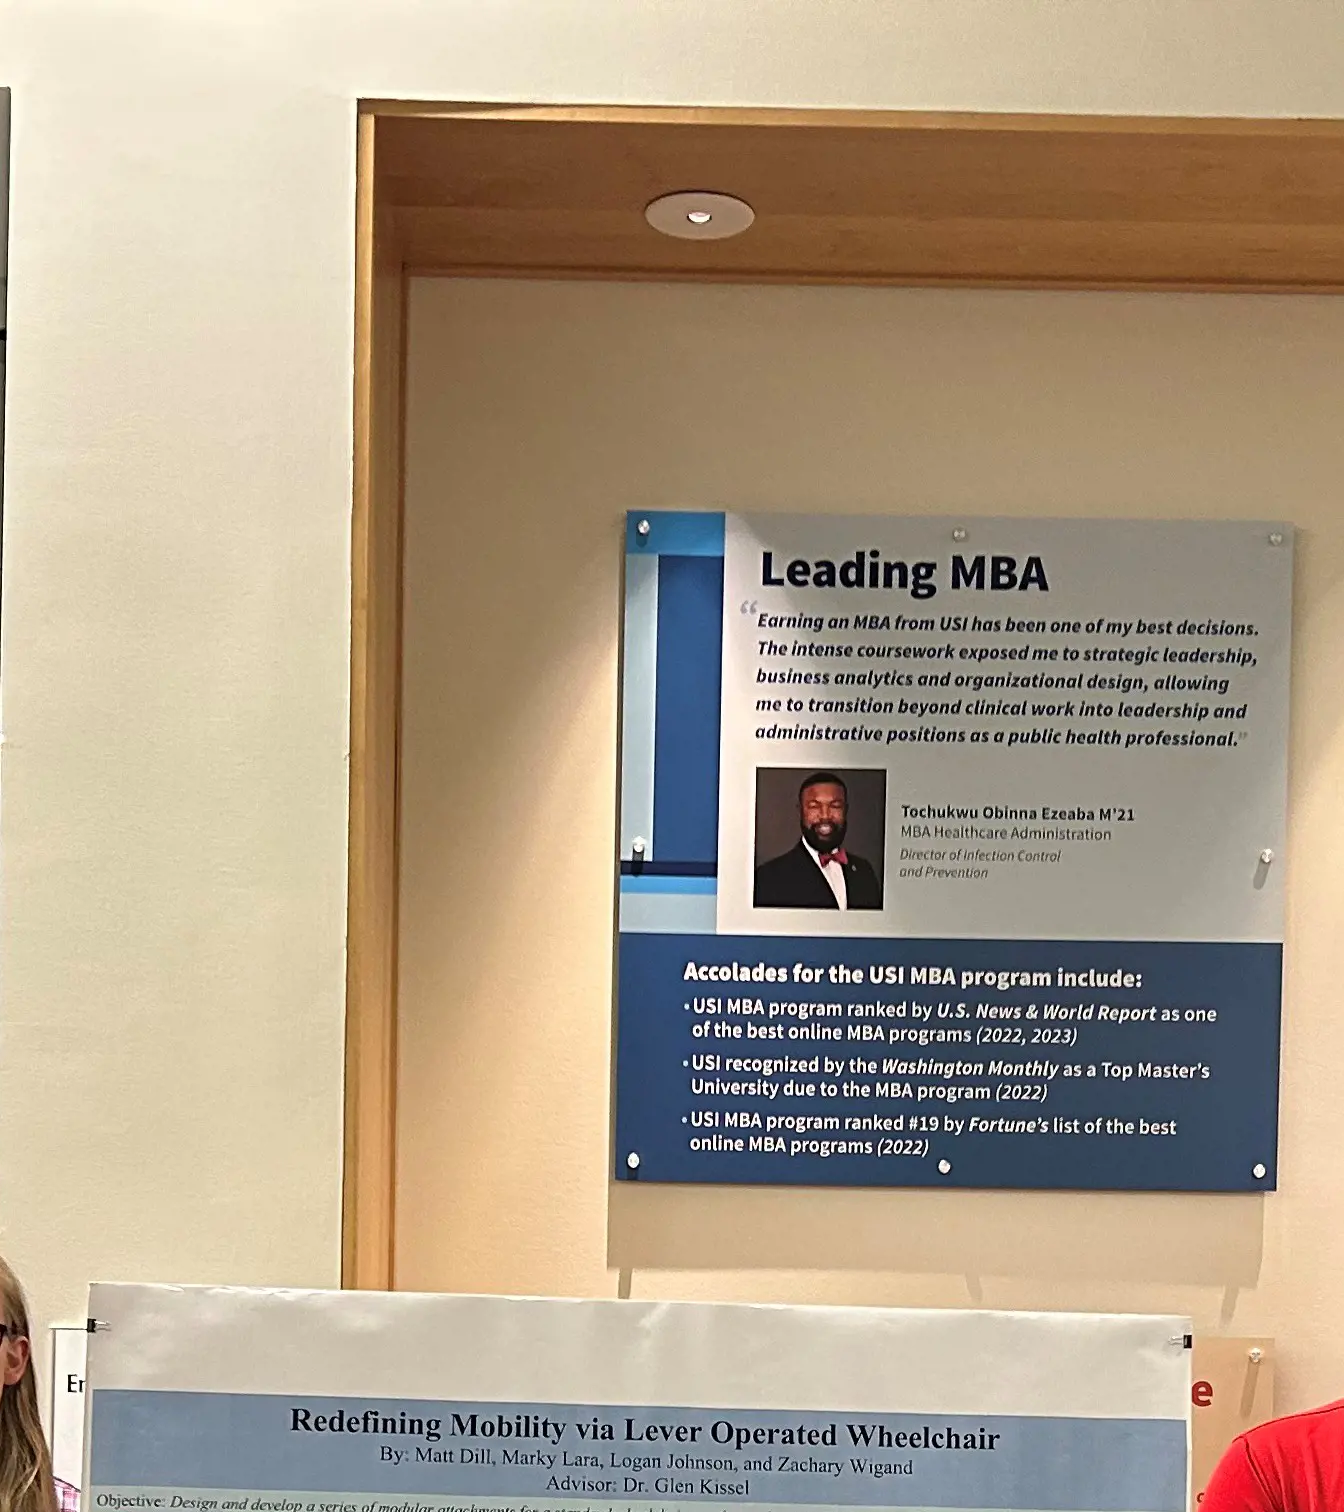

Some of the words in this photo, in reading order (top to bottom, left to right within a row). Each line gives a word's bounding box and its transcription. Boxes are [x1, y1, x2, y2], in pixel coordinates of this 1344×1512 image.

[761, 550, 937, 599] Leading
[950, 554, 1049, 592] MBA
[827, 616, 850, 630] an
[852, 614, 891, 630] MBA
[894, 614, 935, 632] from
[939, 615, 968, 632] USI
[970, 615, 1001, 632] has
[1004, 616, 1046, 633] been
[1050, 620, 1082, 634] one
[1084, 618, 1105, 634] of
[1105, 621, 1133, 638] my
[1135, 618, 1173, 635] best
[1176, 618, 1259, 636] decisions.
[900, 824, 931, 839] MBA
[934, 824, 1008, 840] Healthcare
[1010, 825, 1112, 841] Administration
[899, 847, 947, 861] Director
[948, 847, 963, 861] of
[962, 847, 1015, 862] Infection
[1016, 848, 1062, 863] Control
[682, 961, 788, 983] Accolades
[792, 962, 825, 983] for
[828, 963, 864, 984] the
[869, 965, 904, 985] USI
[910, 966, 956, 985] MBA
[960, 970, 1052, 991] program
[1056, 966, 1142, 988] include:
[692, 1019, 711, 1038] of
[713, 1020, 743, 1039] the
[746, 1020, 784, 1040] best
[787, 1022, 843, 1041] online
[846, 1023, 885, 1041] MBA
[888, 1028, 972, 1046] programs
[976, 1025, 1026, 1046] (2022,
[1030, 1026, 1078, 1047] 2023)
[290, 1407, 442, 1442] Redefining
[449, 1412, 567, 1445] Mobility
[574, 1416, 615, 1441] via
[623, 1417, 703, 1443] Lever
[710, 1420, 837, 1449] Operated
[845, 1423, 1001, 1450] Wheelchair
[380, 1445, 409, 1466] By:
[415, 1446, 454, 1463] Matt
[459, 1447, 496, 1466] Dill,
[502, 1448, 557, 1470] Marky
[562, 1450, 604, 1470] Lara,
[610, 1451, 662, 1473] Logan
[666, 1453, 738, 1473] Johnson,
[742, 1455, 773, 1472] and
[777, 1455, 844, 1478] Zachary
[849, 1458, 913, 1479] Wigand
[545, 1474, 617, 1493] Advisor:
[623, 1476, 649, 1493] Dr.
[654, 1477, 694, 1494] Glen
[700, 1478, 749, 1496] Kissel
[96, 1493, 165, 1510] Objective:
[169, 1494, 218, 1512] Design
[220, 1497, 249, 1510] and
[305, 1503, 316, 1512] a
[319, 1502, 357, 1512] series
